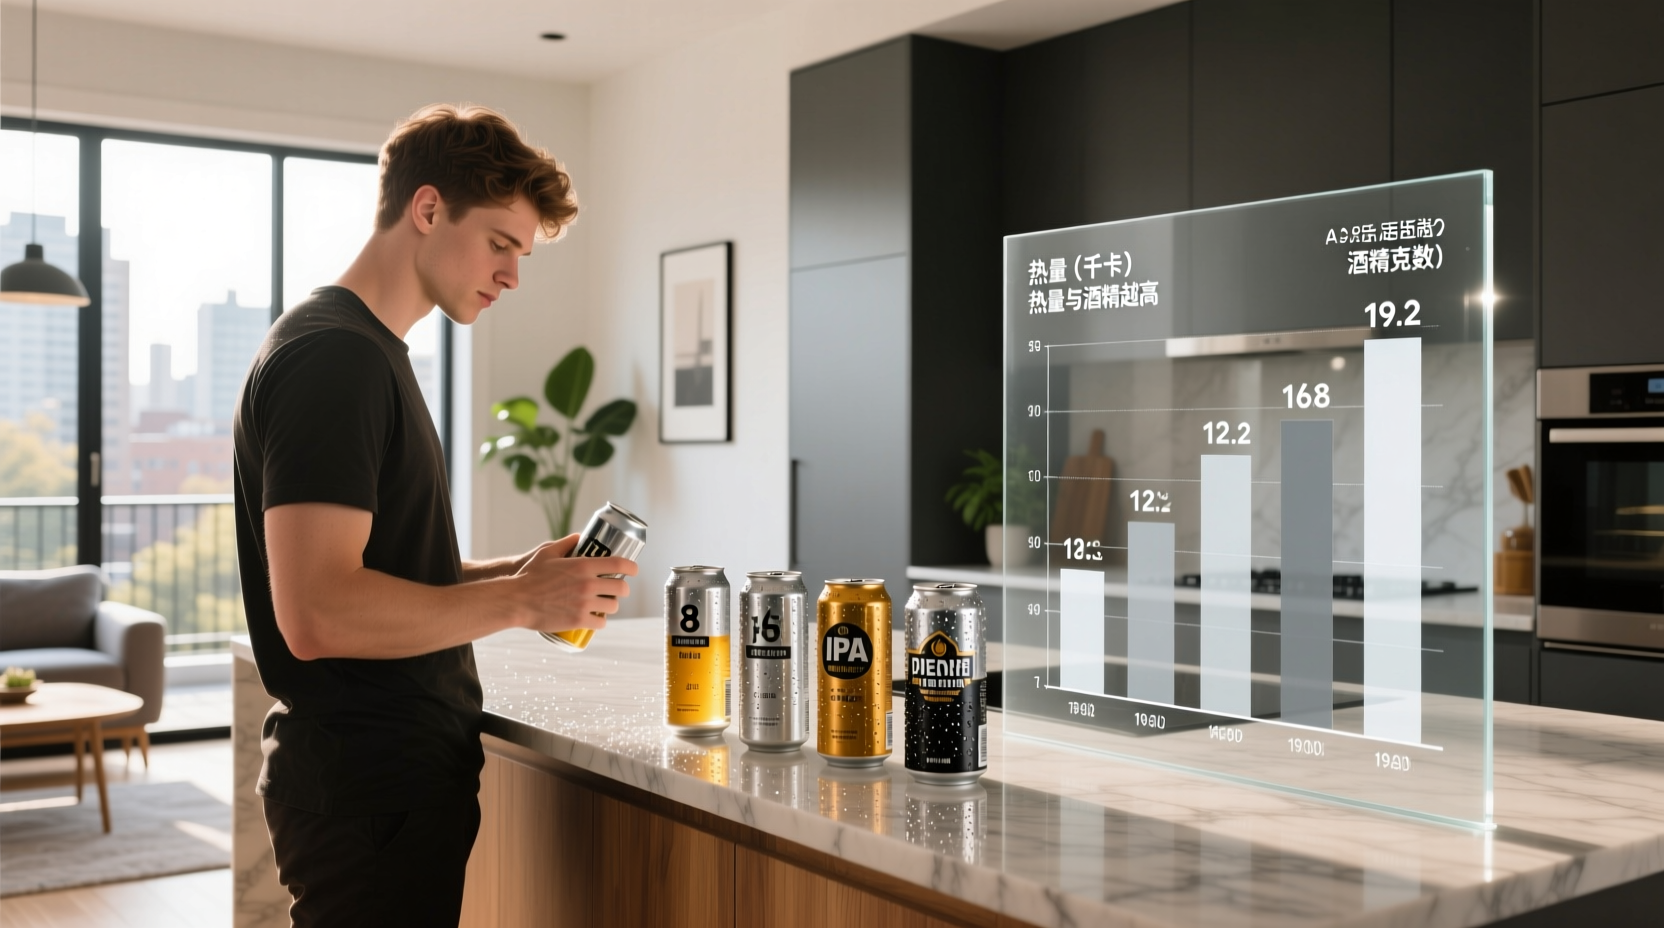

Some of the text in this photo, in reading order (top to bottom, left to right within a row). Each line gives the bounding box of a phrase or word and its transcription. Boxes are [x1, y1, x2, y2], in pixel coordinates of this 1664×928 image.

[1028, 280, 1159, 315] 热量与酒精越高
[1364, 299, 1421, 328] 19.2
[1282, 383, 1330, 409] 168
[1203, 421, 1251, 445] 12.2
[680, 604, 700, 633] 8
[826, 636, 869, 663] IPA
